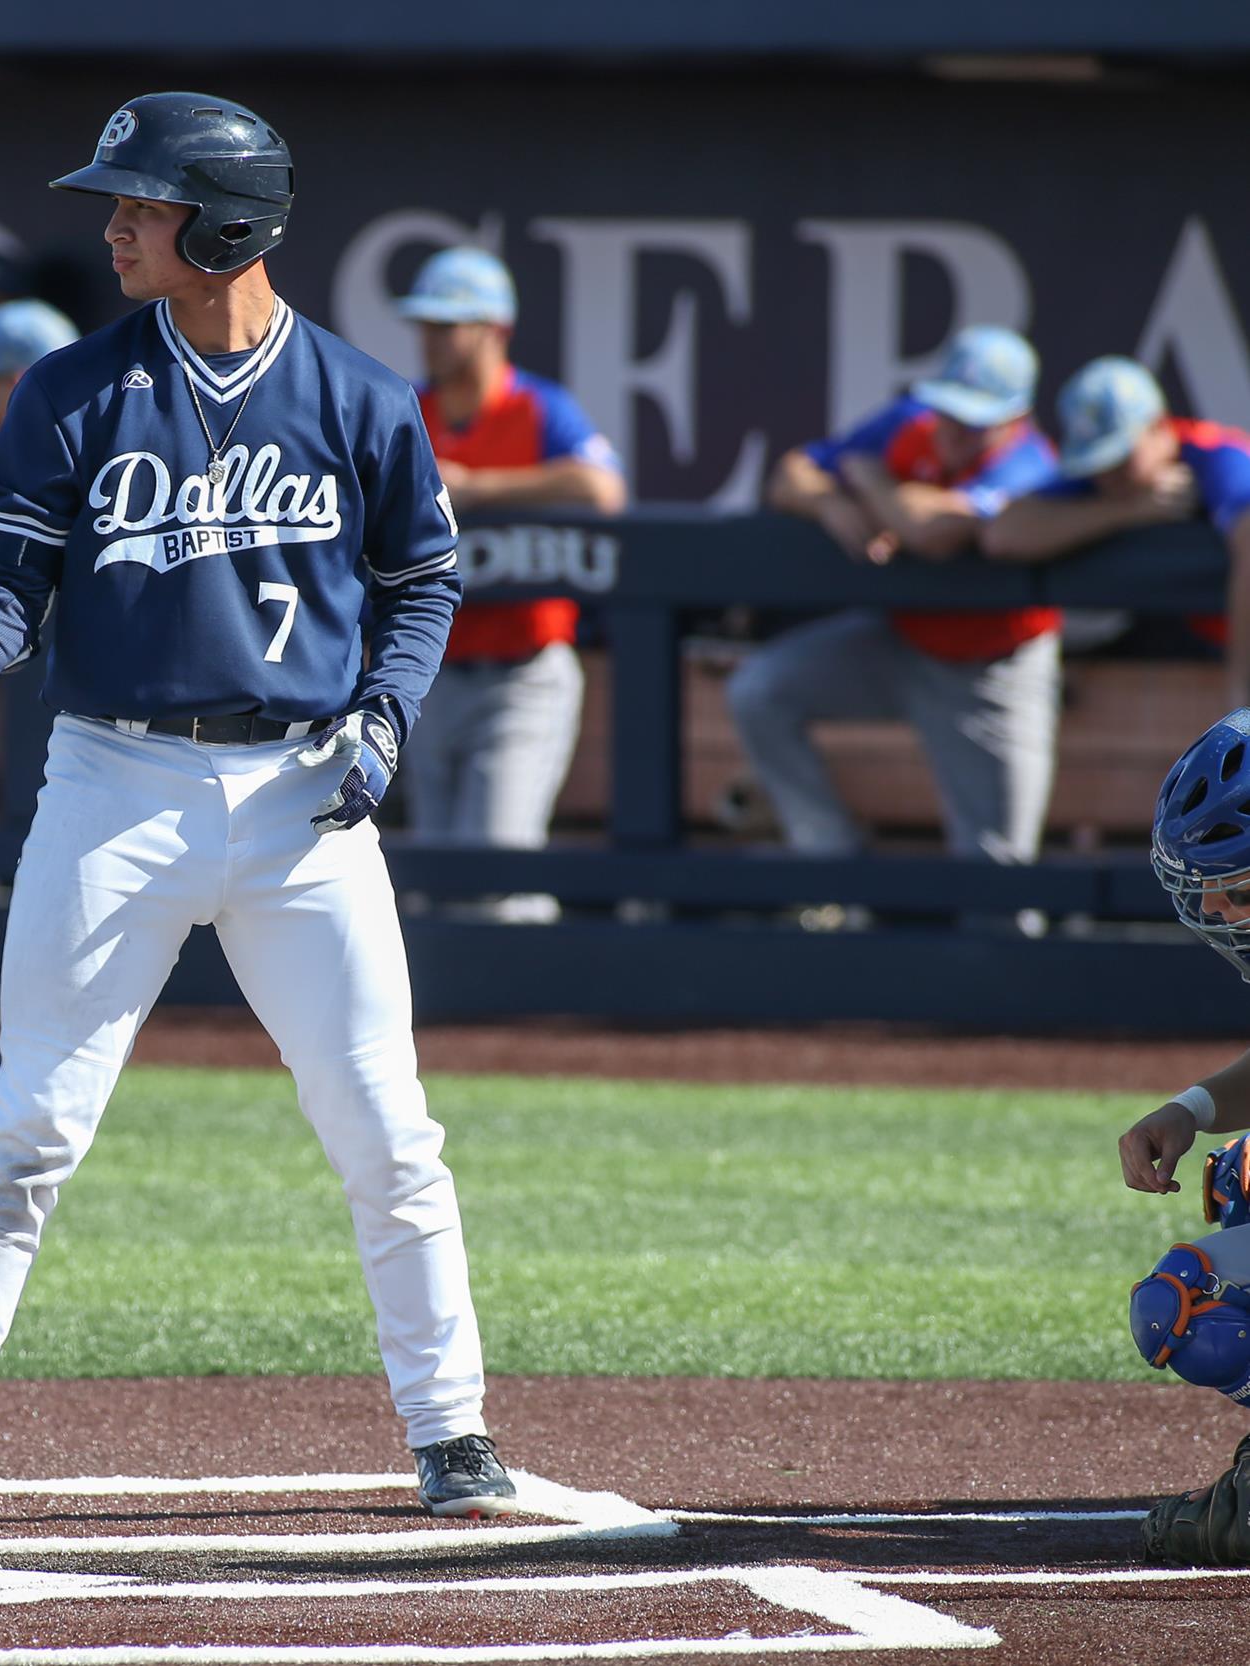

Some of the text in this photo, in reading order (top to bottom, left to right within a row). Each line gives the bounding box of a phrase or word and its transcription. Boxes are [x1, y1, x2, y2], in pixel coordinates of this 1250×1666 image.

[88, 443, 342, 535] Dallas
[163, 529, 261, 565] BAPTIST
[457, 523, 621, 593] DBU
[257, 581, 299, 663] 7
